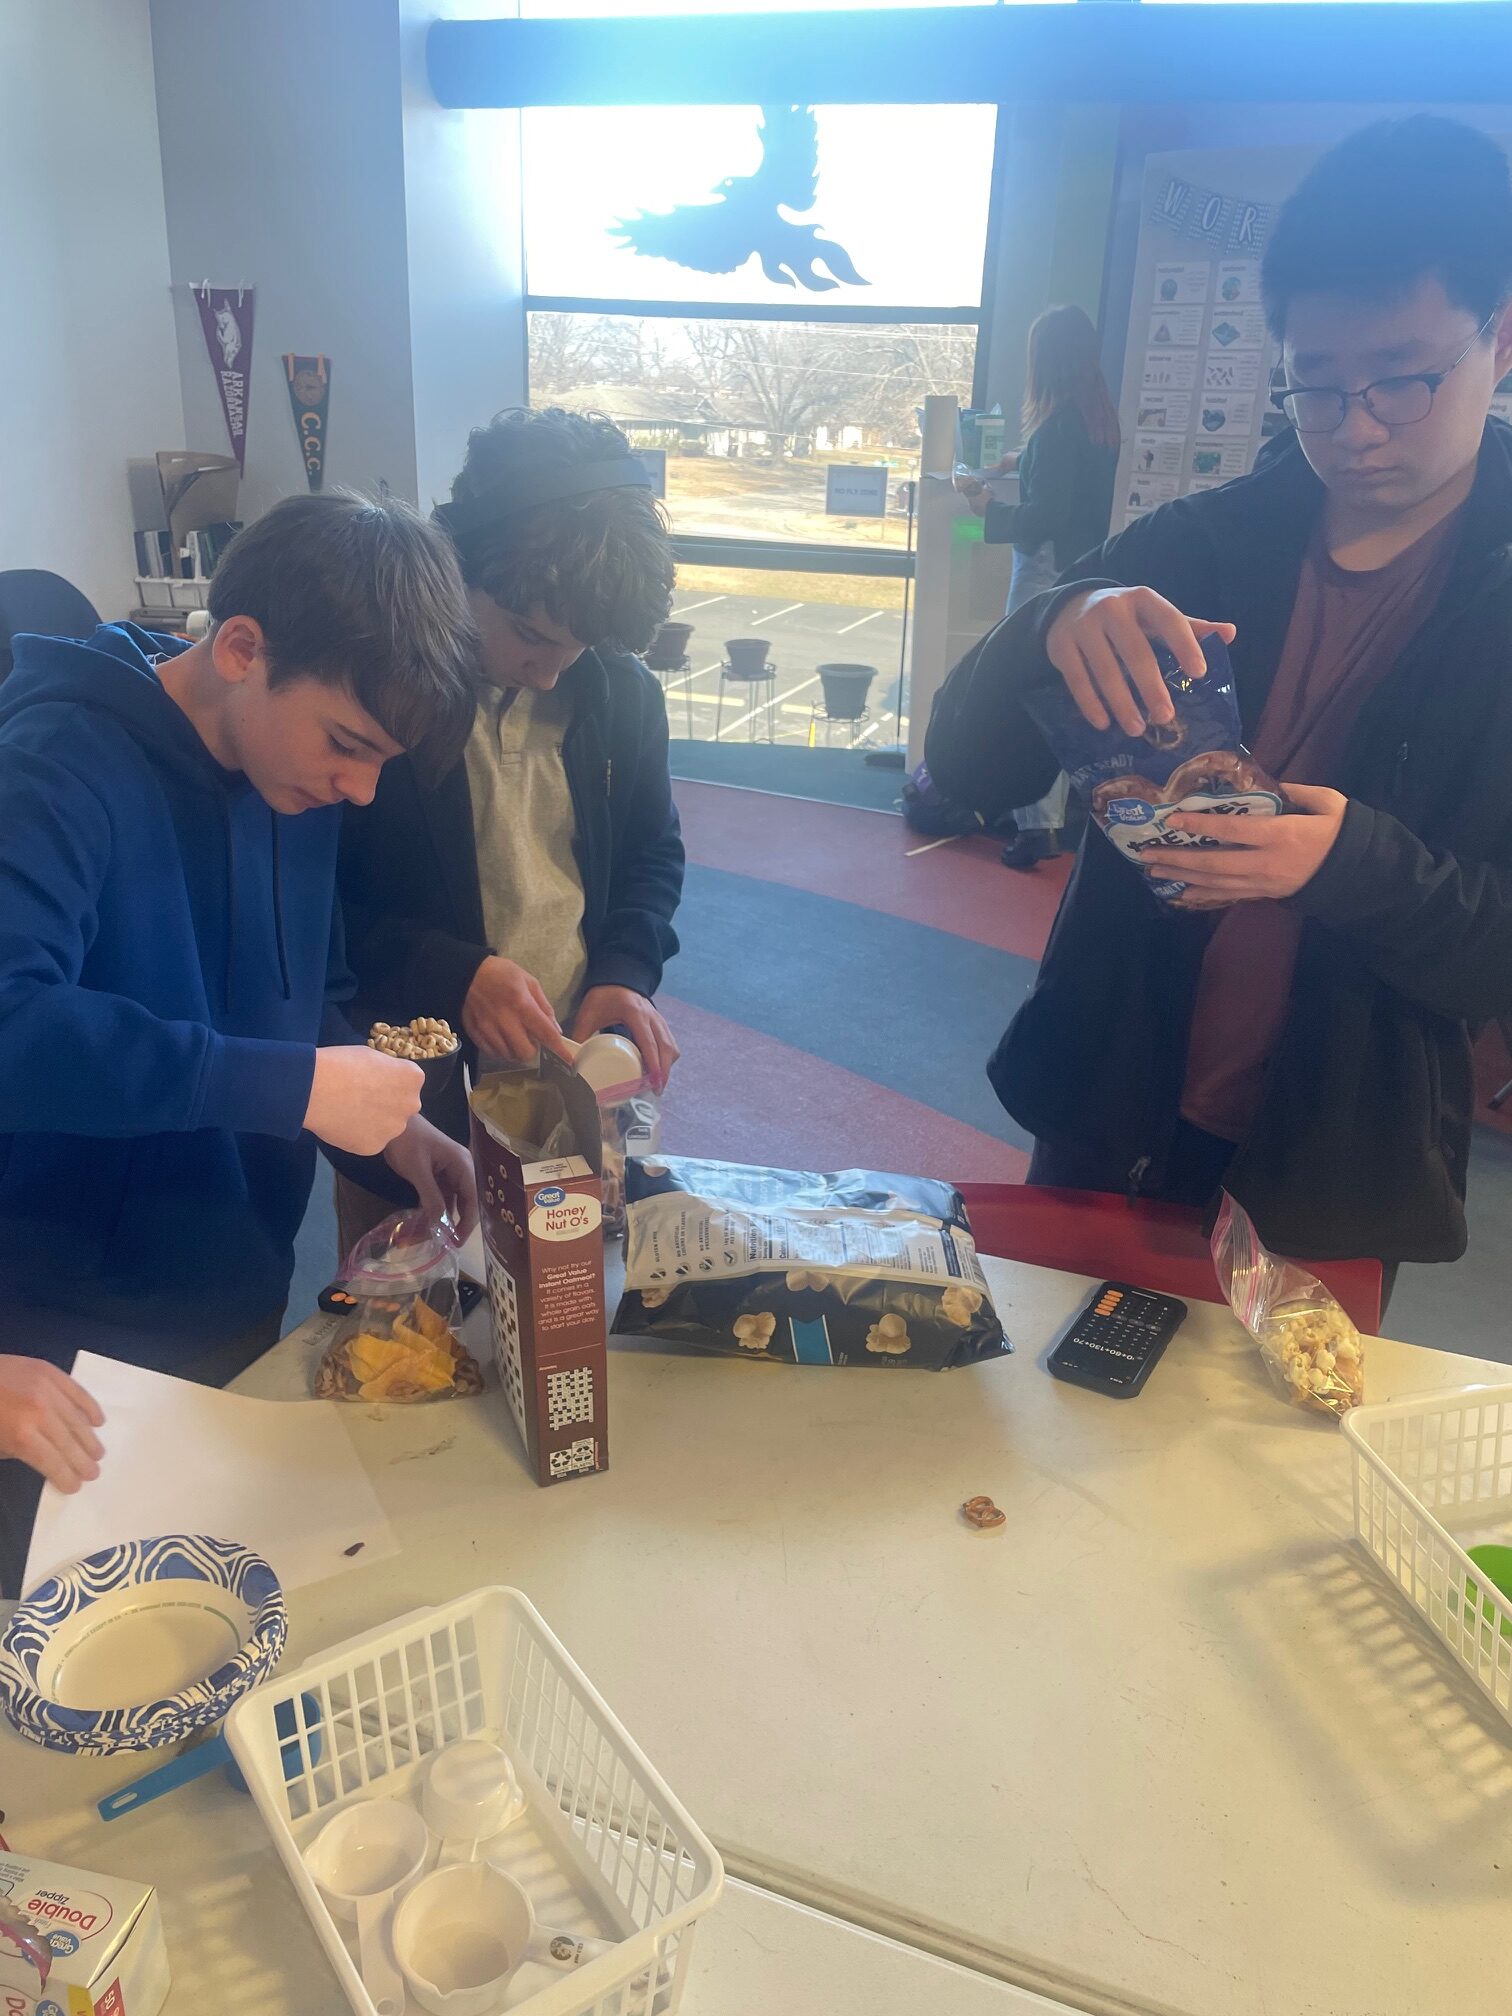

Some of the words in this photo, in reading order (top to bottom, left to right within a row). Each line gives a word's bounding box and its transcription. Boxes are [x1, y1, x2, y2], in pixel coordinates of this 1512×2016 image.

[230, 371, 244, 435] ARKANSAS
[538, 1191, 560, 1201] Great
[546, 1206, 586, 1219] Honey
[545, 1220, 567, 1231] Nut
[570, 1216, 589, 1227] O's
[547, 1272, 567, 1280] Great
[568, 1268, 587, 1276] Value
[539, 1280, 561, 1288] Instant
[556, 1299, 577, 1307] made
[541, 1309, 562, 1317] whole
[566, 1311, 584, 1320] great
[34, 1889, 70, 1905] Zipper
[27, 1898, 97, 1931] Double
